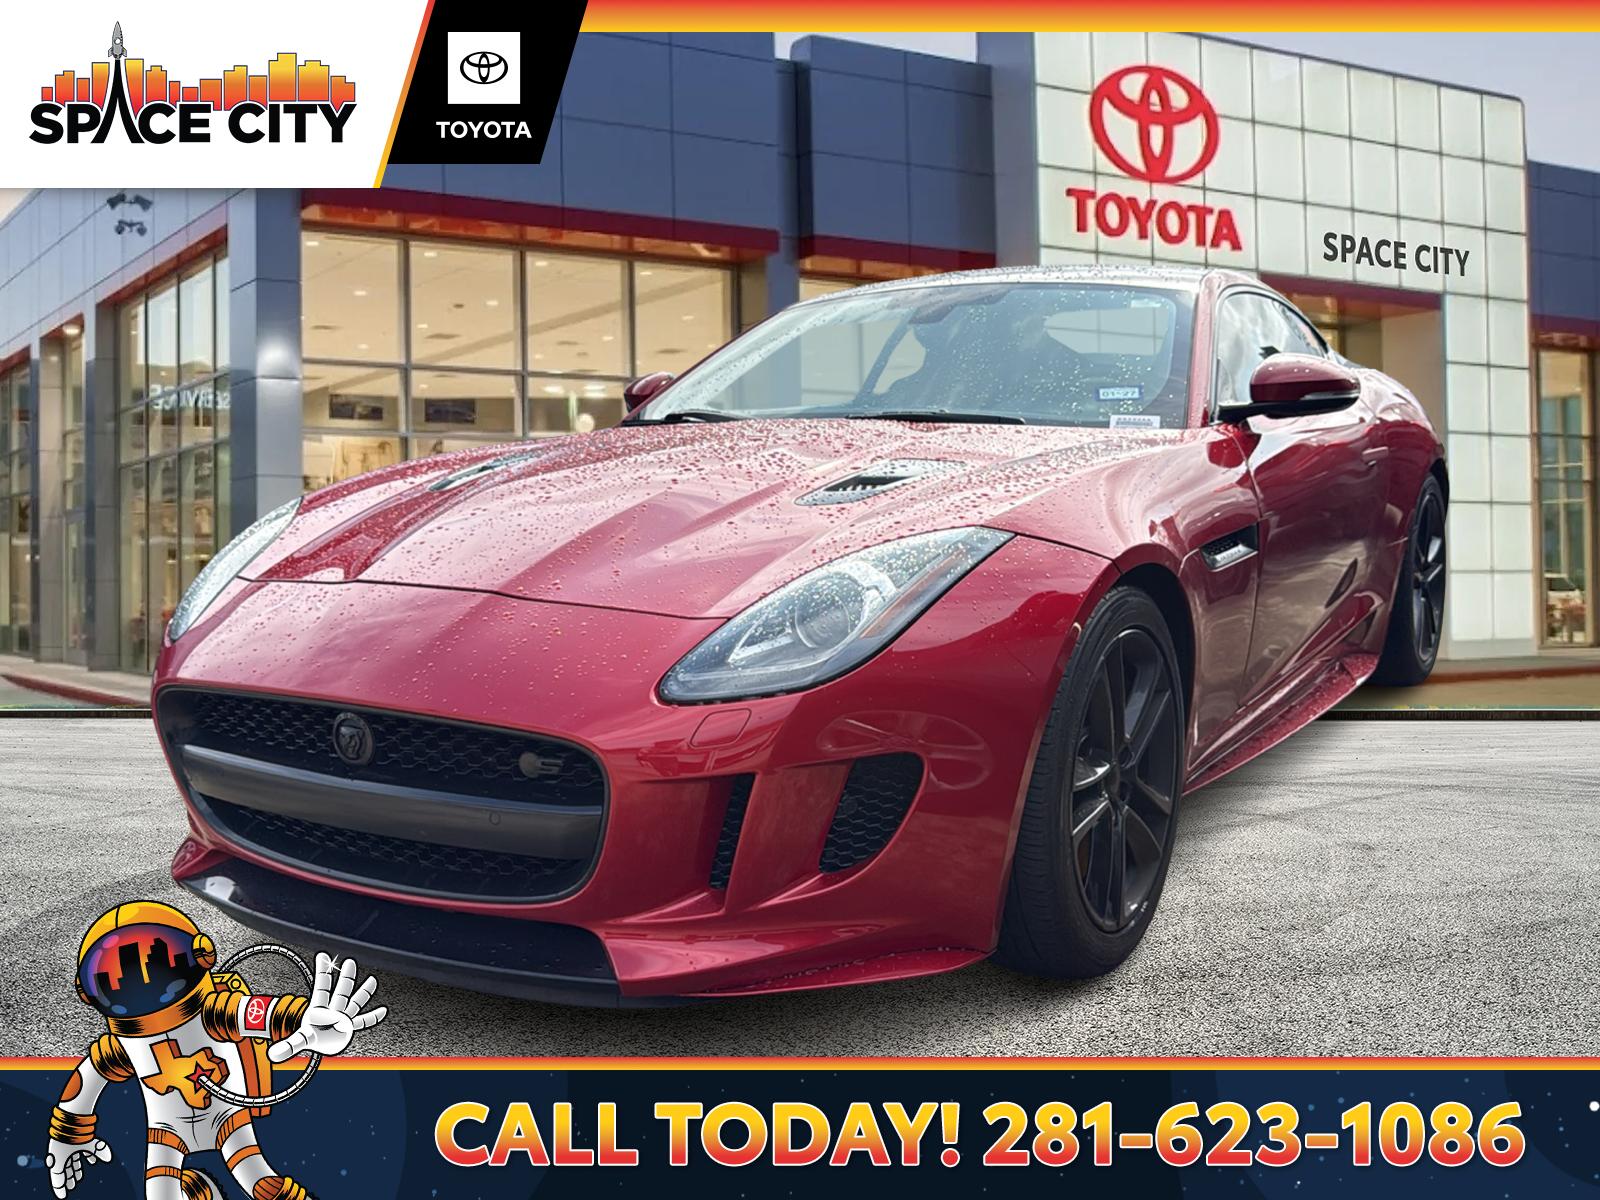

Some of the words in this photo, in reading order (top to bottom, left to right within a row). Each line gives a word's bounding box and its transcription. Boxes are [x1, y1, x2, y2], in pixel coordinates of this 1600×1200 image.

[1066, 187, 1242, 251] TOYOTA
[1323, 232, 1407, 269] SPACE
[1415, 243, 1470, 277] CITY
